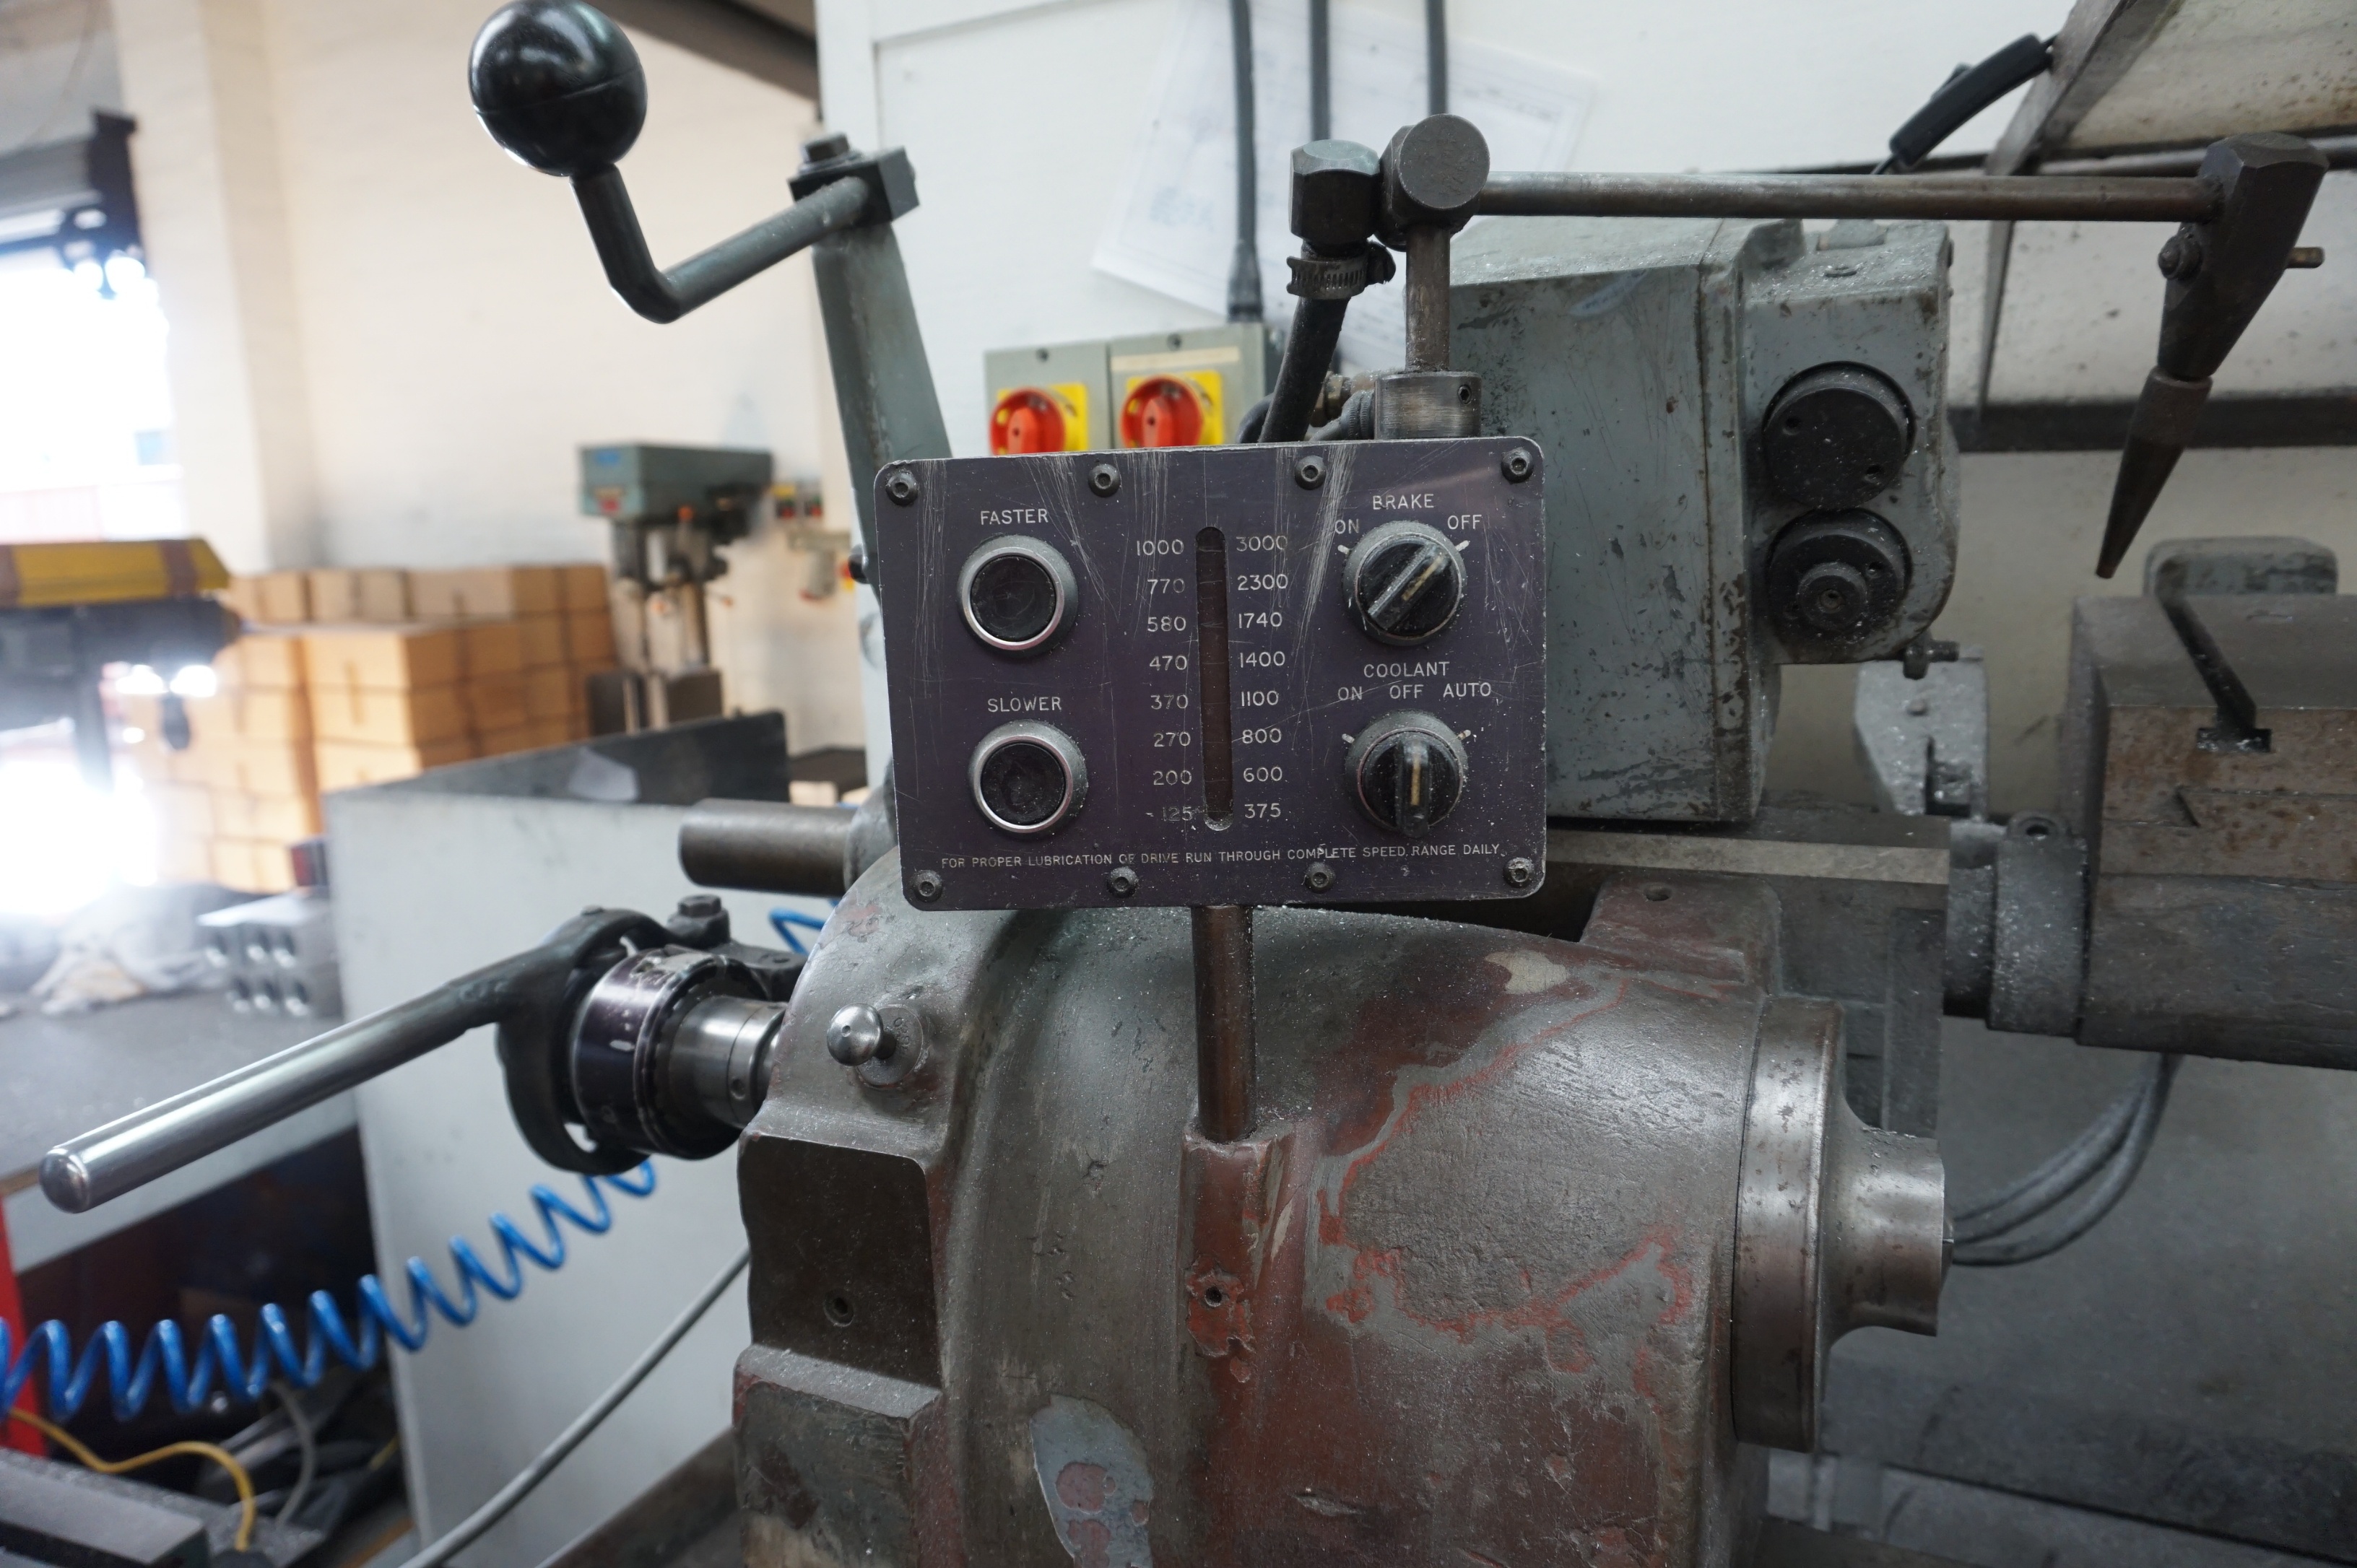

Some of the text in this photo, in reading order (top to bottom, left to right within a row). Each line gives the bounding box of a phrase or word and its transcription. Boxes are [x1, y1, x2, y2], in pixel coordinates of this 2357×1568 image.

[1373, 493, 1434, 510] BRAKE
[981, 508, 1049, 525] FASTER
[1334, 515, 1482, 534] ON OFF
[1136, 539, 1184, 556] 1000
[1236, 536, 1288, 552] 3000
[1147, 578, 1185, 594] 770
[1237, 574, 1288, 591] 2300
[1147, 616, 1186, 632] 580
[1238, 612, 1282, 629] 1740
[1149, 655, 1187, 671] 470
[1240, 651, 1285, 668] 1400
[1363, 661, 1450, 678] COOLANT
[1241, 691, 1279, 707] 1100
[1337, 682, 1491, 701] ON OFF AUTO
[987, 696, 1062, 712] SLOWER
[1150, 694, 1189, 710] 370
[1153, 731, 1191, 747] 270
[1242, 728, 1282, 744] 800
[1153, 770, 1191, 785] 200
[1243, 767, 1282, 782] 600
[1162, 806, 1193, 822] 125
[1244, 803, 1281, 819] 375
[942, 858, 965, 868] FOR
[972, 856, 1022, 867] PROPER
[1028, 854, 1112, 866] LUBRICATION
[1119, 854, 1134, 864] OF
[1141, 853, 1178, 863] DRIVE
[1186, 852, 1212, 863] RUN
[1218, 850, 1280, 862] THROUGH
[1287, 847, 1356, 859] COMPLETE
[1412, 845, 1456, 856] RANGE
